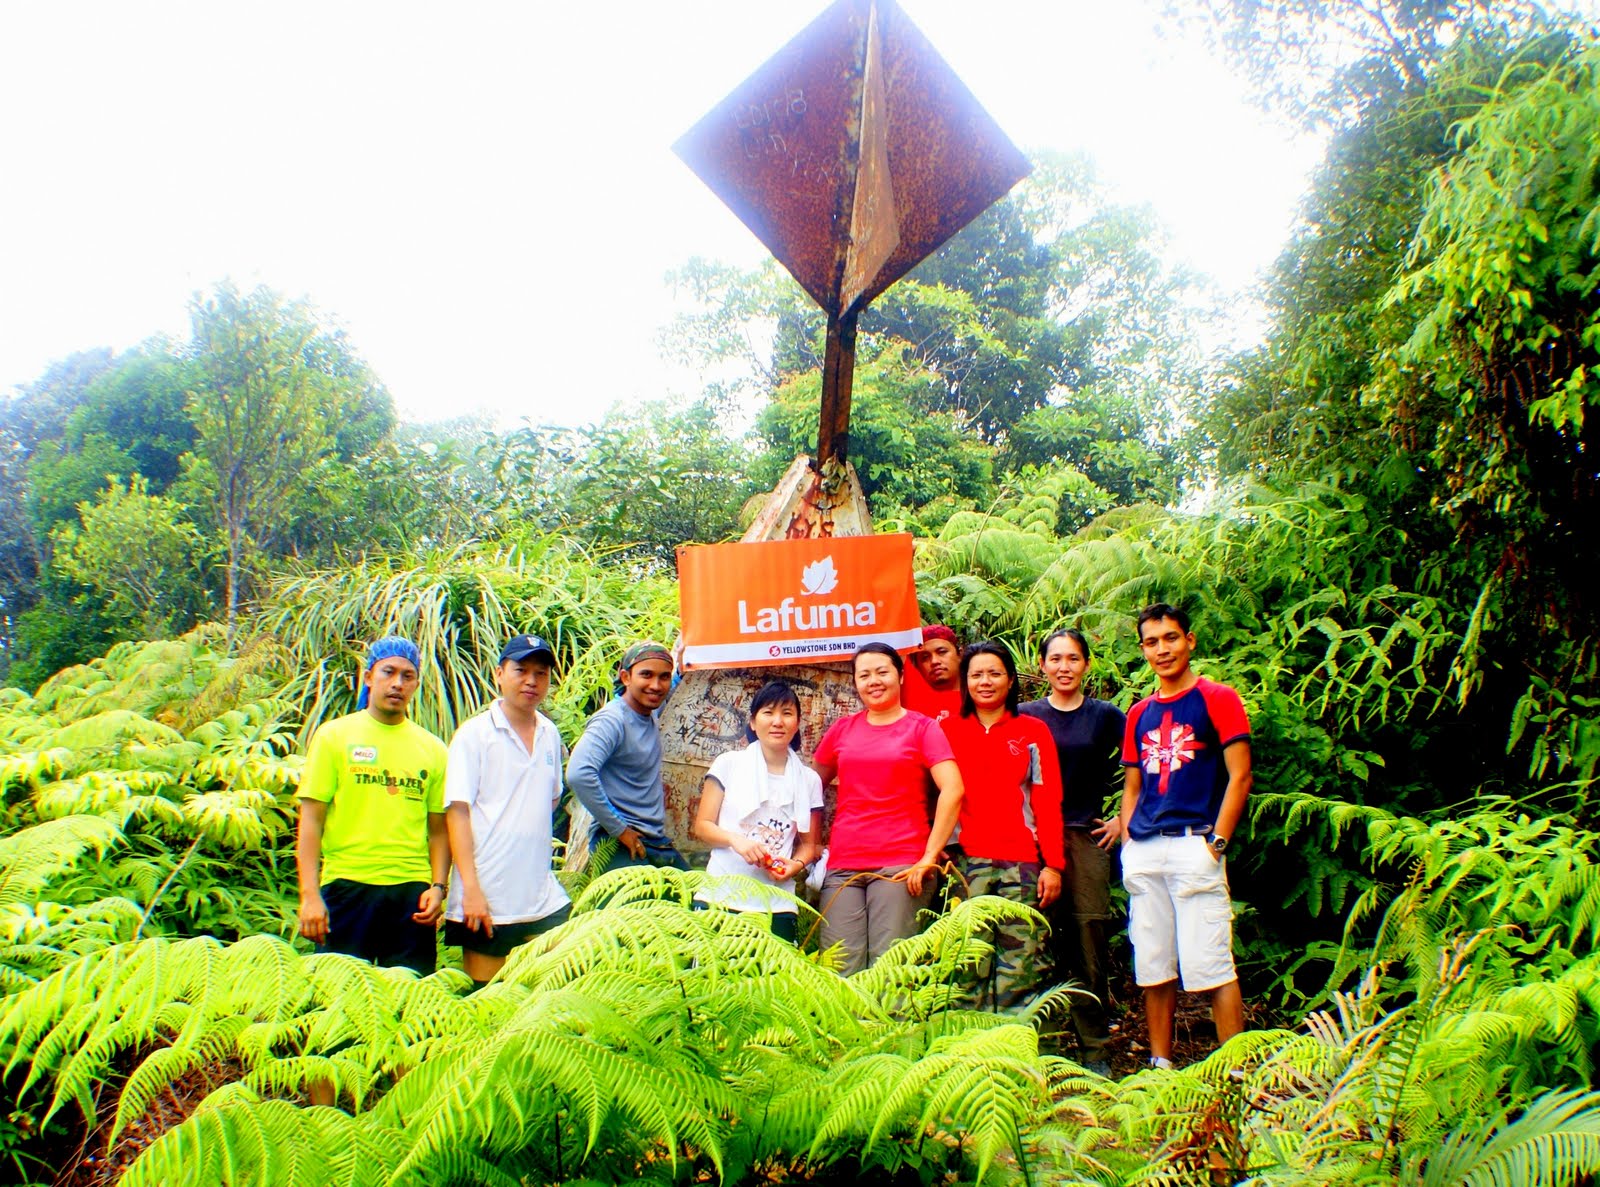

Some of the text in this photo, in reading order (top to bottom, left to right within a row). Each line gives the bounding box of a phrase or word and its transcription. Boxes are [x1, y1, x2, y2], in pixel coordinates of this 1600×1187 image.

[738, 597, 876, 634] Lafuma
[782, 644, 827, 654] YELLOWSTONE
[829, 643, 841, 651] SDN
[355, 774, 423, 789] TRAILBLAZER
